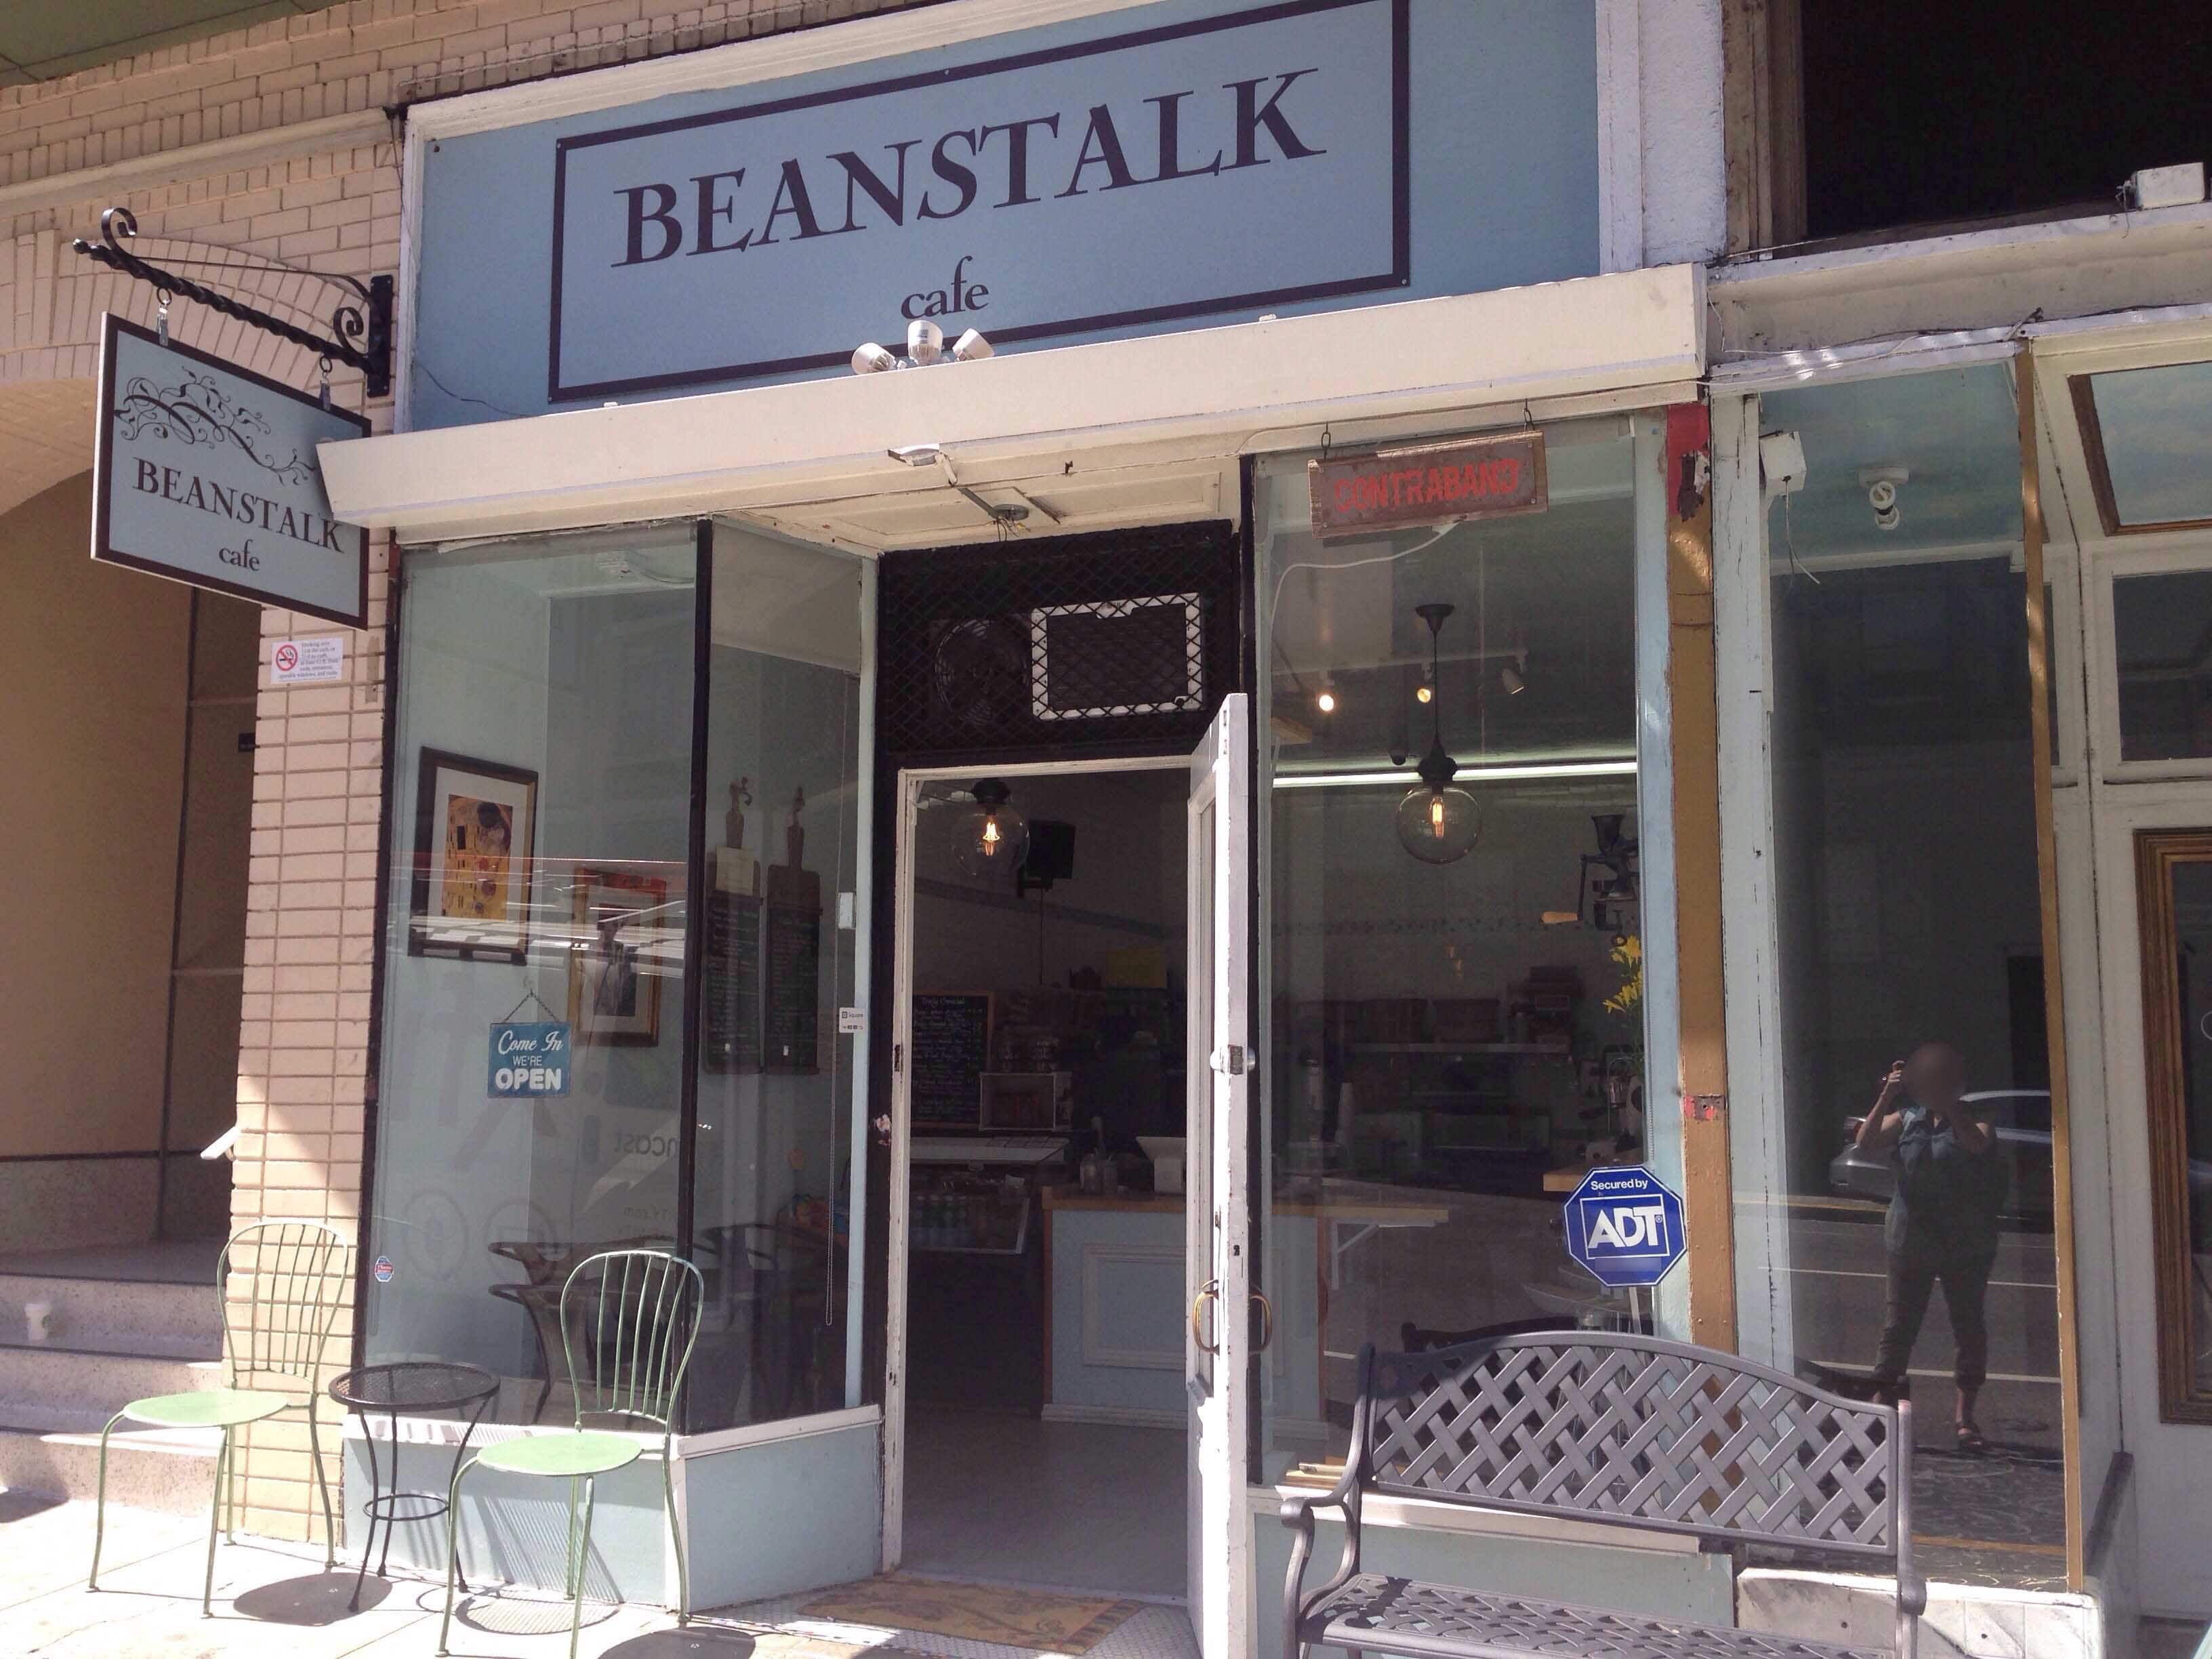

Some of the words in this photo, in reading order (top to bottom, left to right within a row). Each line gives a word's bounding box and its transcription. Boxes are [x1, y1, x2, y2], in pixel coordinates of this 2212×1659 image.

[611, 67, 1328, 268] BEANSTALK
[901, 255, 989, 319] cafe
[1334, 459, 1519, 512] CONTRABAND
[133, 457, 344, 553] BEANSTALK
[218, 539, 260, 571] cafe
[498, 1030, 537, 1055] Come
[541, 1031, 564, 1051] In
[512, 1055, 543, 1066] WE'RE
[495, 1067, 562, 1090] OPEN
[1591, 1179, 1634, 1190] Secured
[1635, 1179, 1648, 1189] by
[1588, 1206, 1662, 1248] ADT
